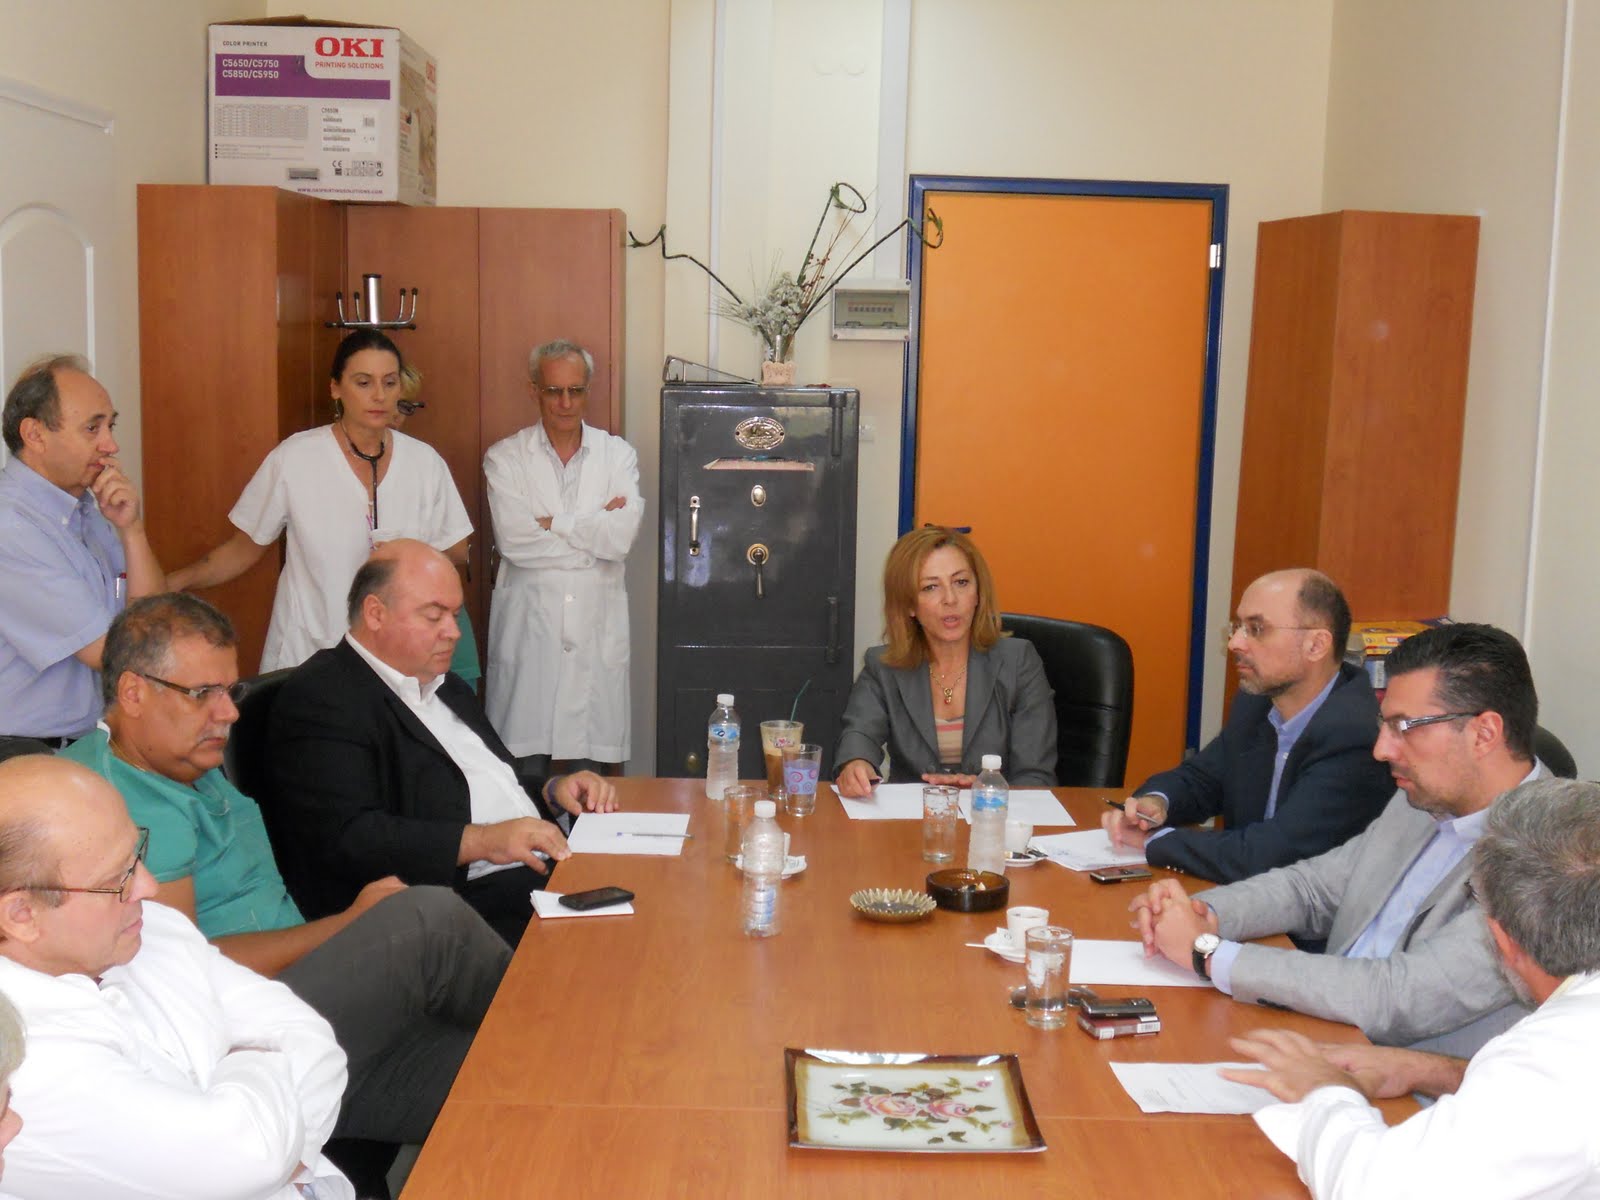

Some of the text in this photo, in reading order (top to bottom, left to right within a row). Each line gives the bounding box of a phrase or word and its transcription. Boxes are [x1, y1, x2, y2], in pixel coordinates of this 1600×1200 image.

[315, 37, 384, 57] OKI
[222, 58, 279, 68] C5650/C5750
[315, 61, 346, 69] PRINTING
[222, 69, 279, 79] C5850/C5950
